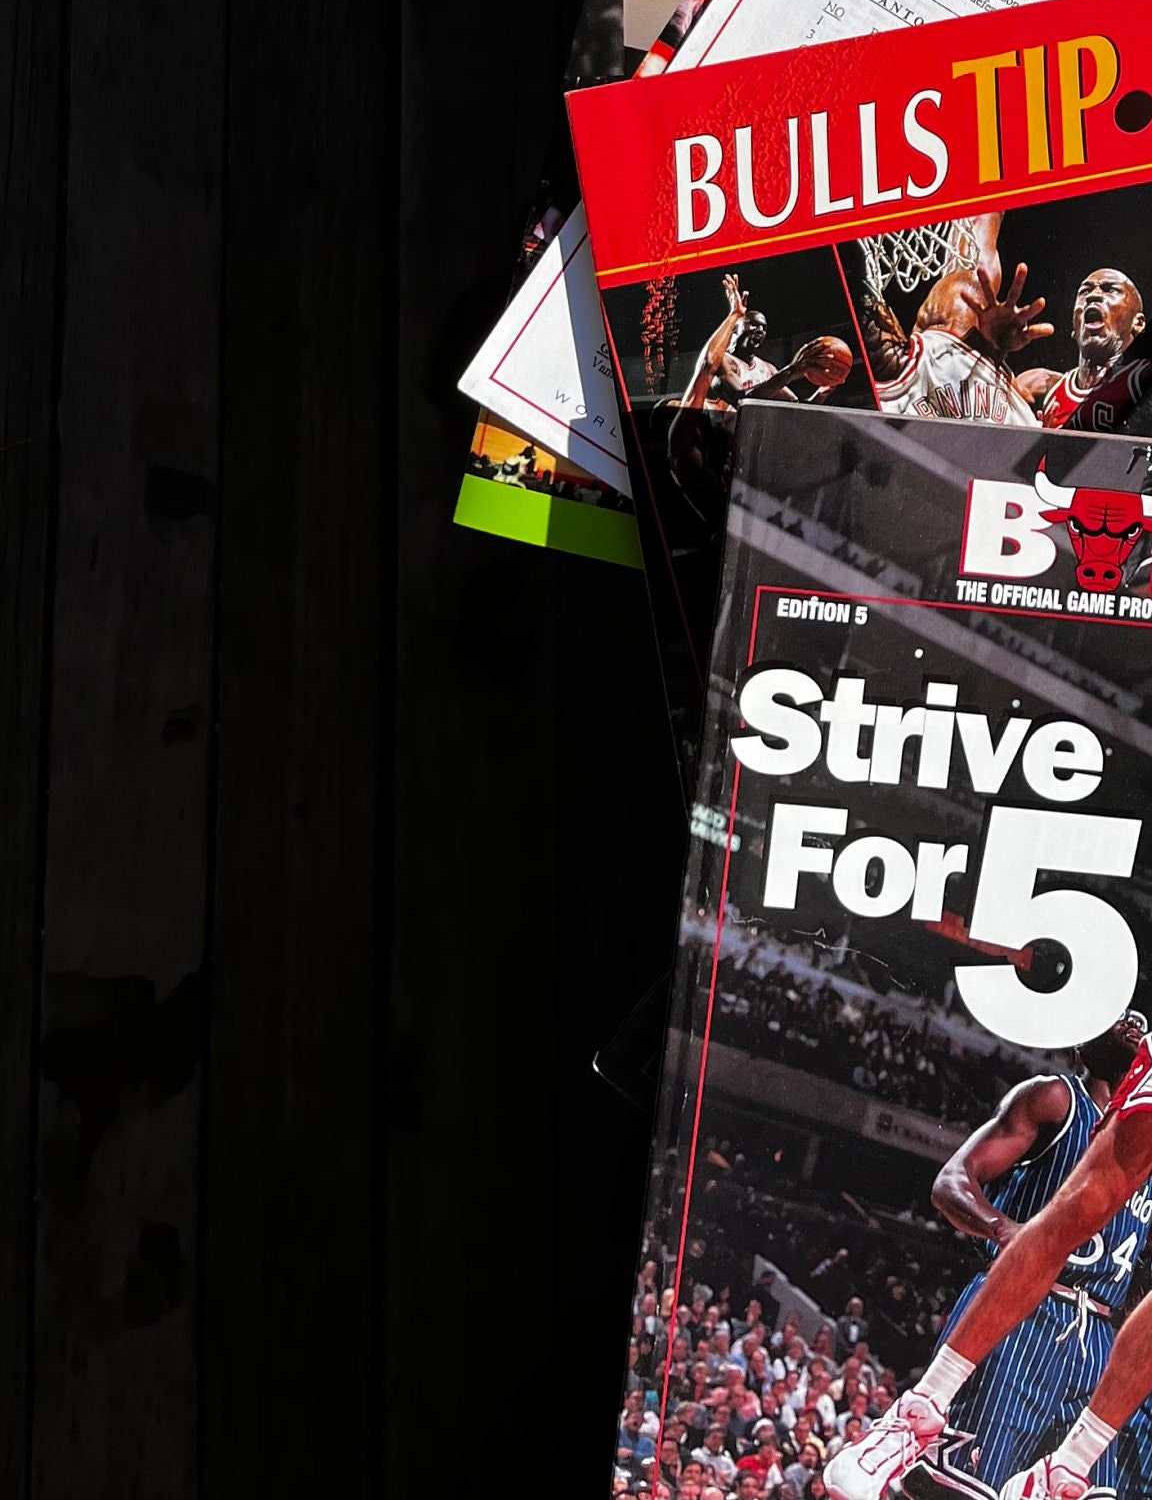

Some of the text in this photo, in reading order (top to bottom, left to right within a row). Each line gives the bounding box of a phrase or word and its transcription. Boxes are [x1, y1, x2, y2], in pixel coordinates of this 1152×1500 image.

[671, 88, 951, 245] BULLS
[777, 598, 869, 625] EDITION 5
[956, 580, 988, 604] THE
[990, 582, 1065, 612] OFFICIAL
[1066, 591, 1116, 617] GAME
[730, 668, 1104, 802] Strive
[763, 802, 1143, 1049] For 5
